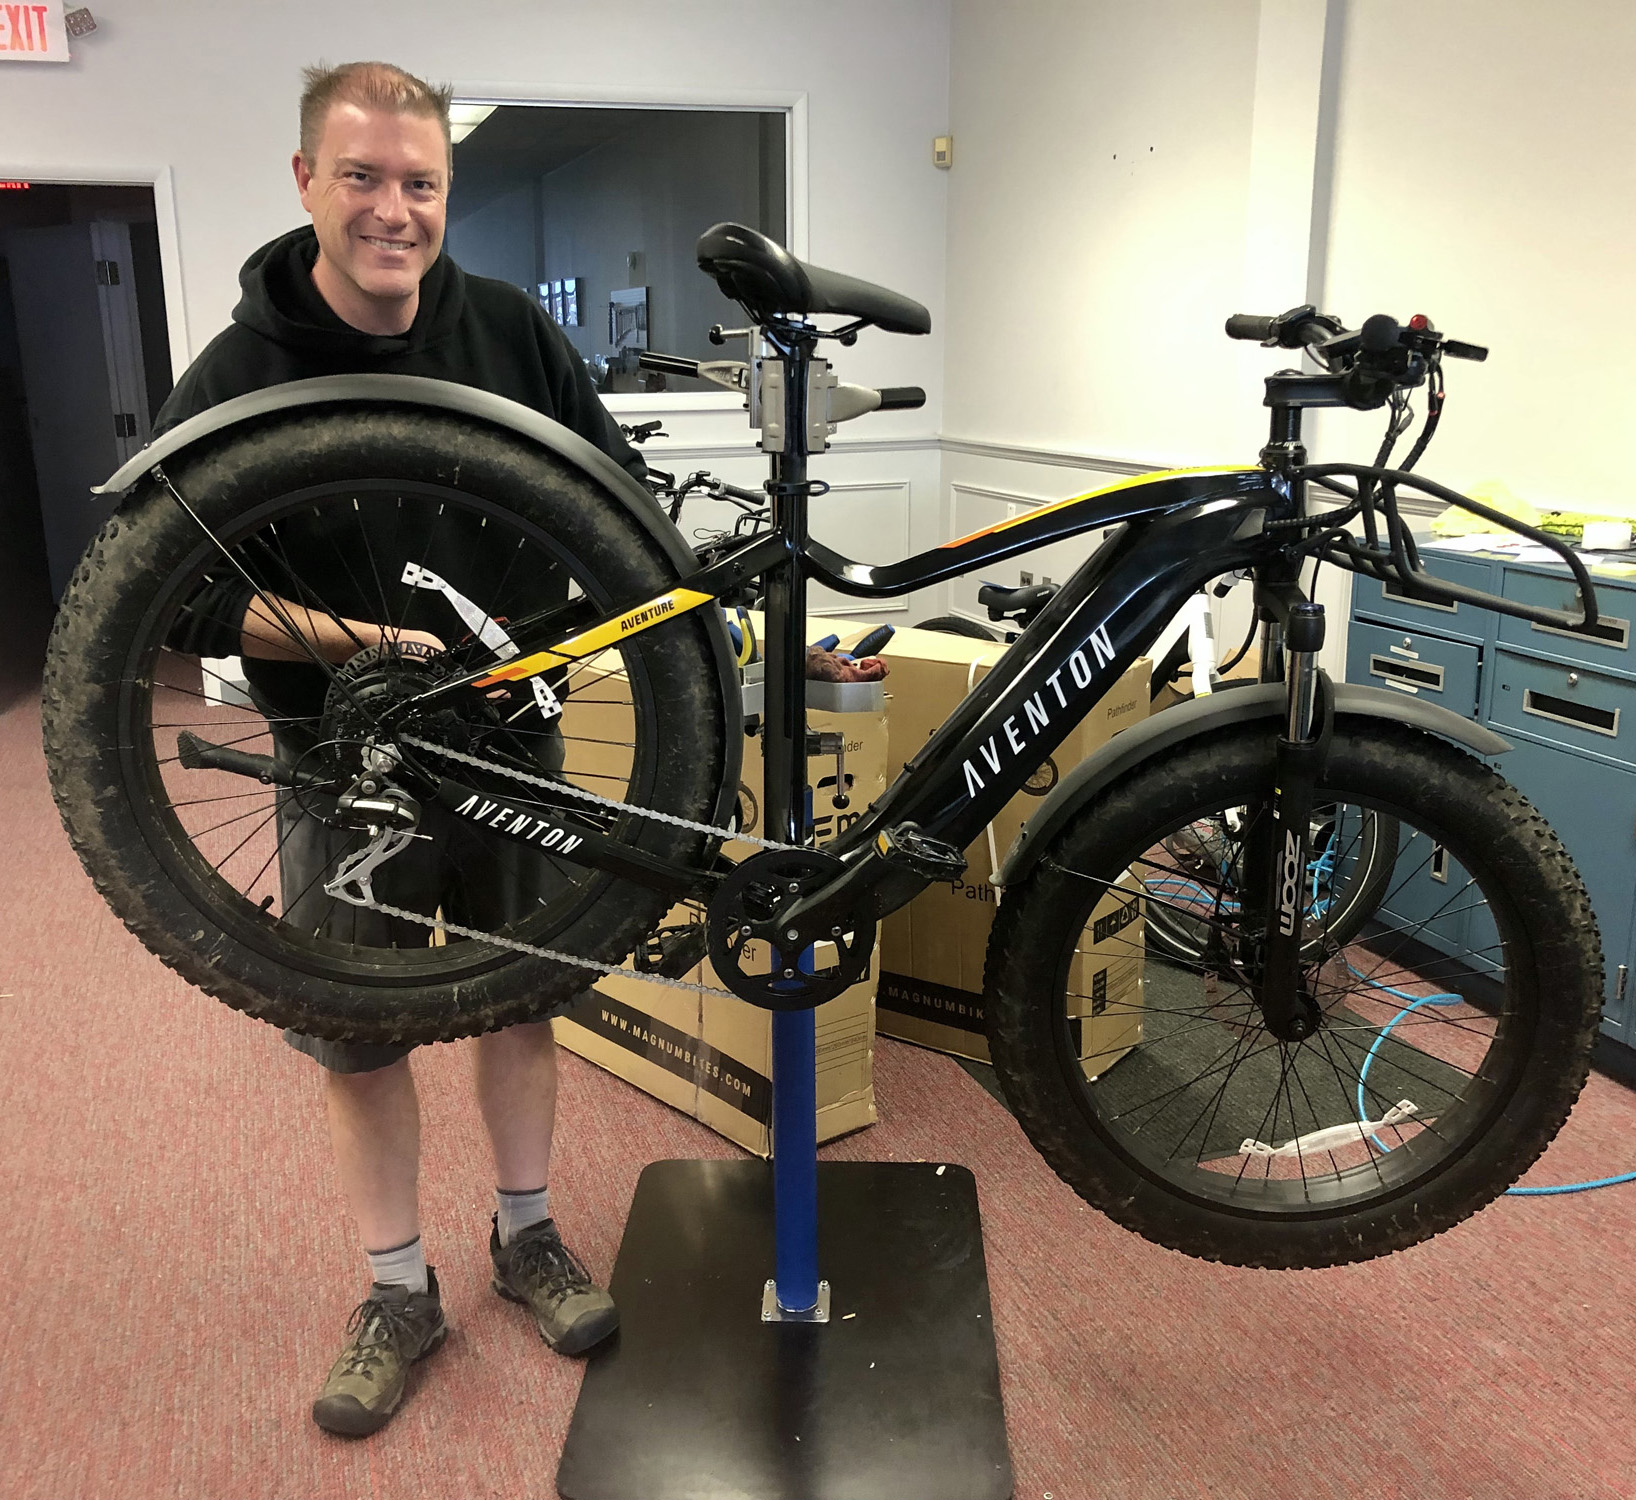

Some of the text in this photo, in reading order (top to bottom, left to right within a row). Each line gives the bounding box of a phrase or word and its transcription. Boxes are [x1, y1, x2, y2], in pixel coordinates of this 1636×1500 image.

[620, 599, 675, 632] AVENTURE
[962, 623, 1117, 799] AVENTON
[1106, 699, 1138, 720] Pathfinder
[454, 794, 584, 855] AVENTON
